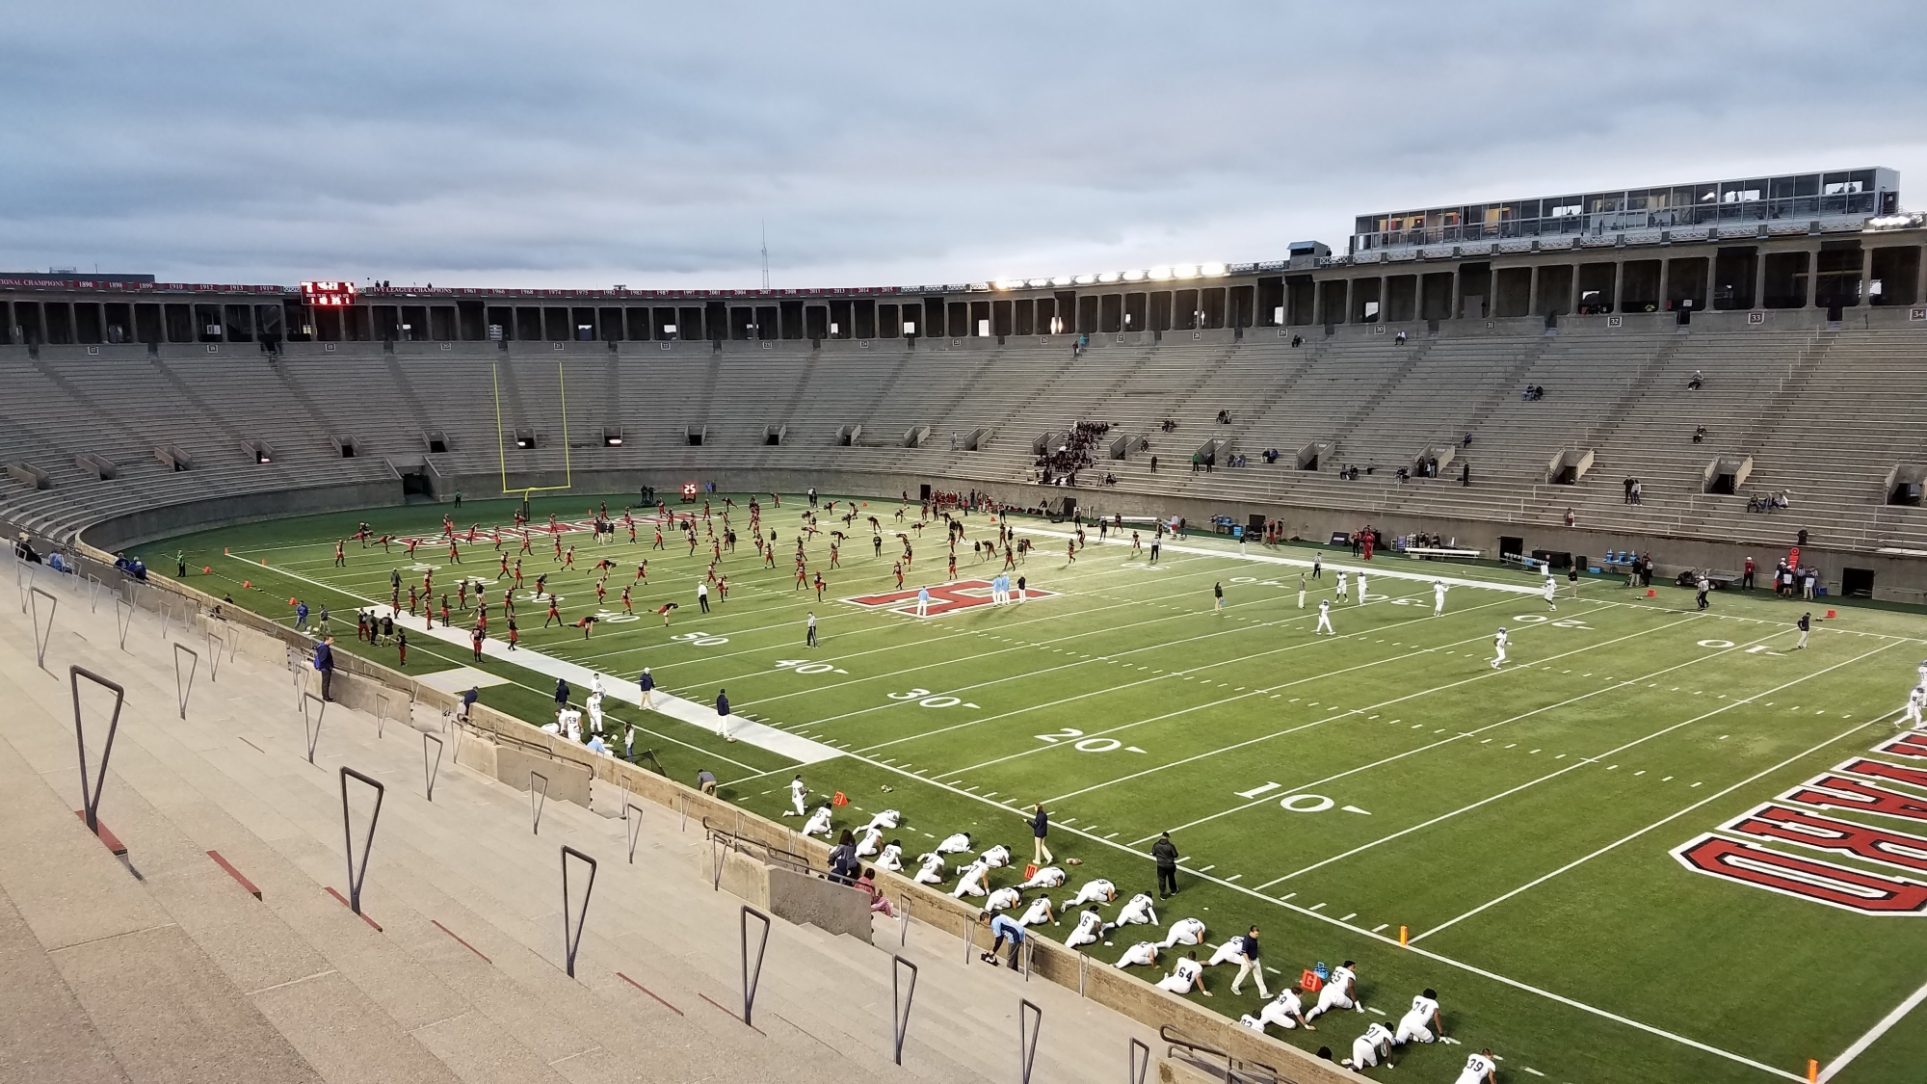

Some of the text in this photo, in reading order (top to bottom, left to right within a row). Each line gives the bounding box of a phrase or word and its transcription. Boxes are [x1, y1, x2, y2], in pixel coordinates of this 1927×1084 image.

[23, 279, 64, 287] CHAMPIONS
[684, 484, 696, 494] 25
[670, 631, 729, 646] 50
[775, 659, 834, 674] 40
[887, 688, 961, 708] 30
[1033, 728, 1121, 752] 20
[1233, 781, 1335, 812] 10
[1027, 865, 1036, 878] 10
[1178, 967, 1193, 982] 64
[1304, 973, 1315, 988] G
[1415, 1001, 1428, 1015] 74
[1467, 1059, 1484, 1072] 39
